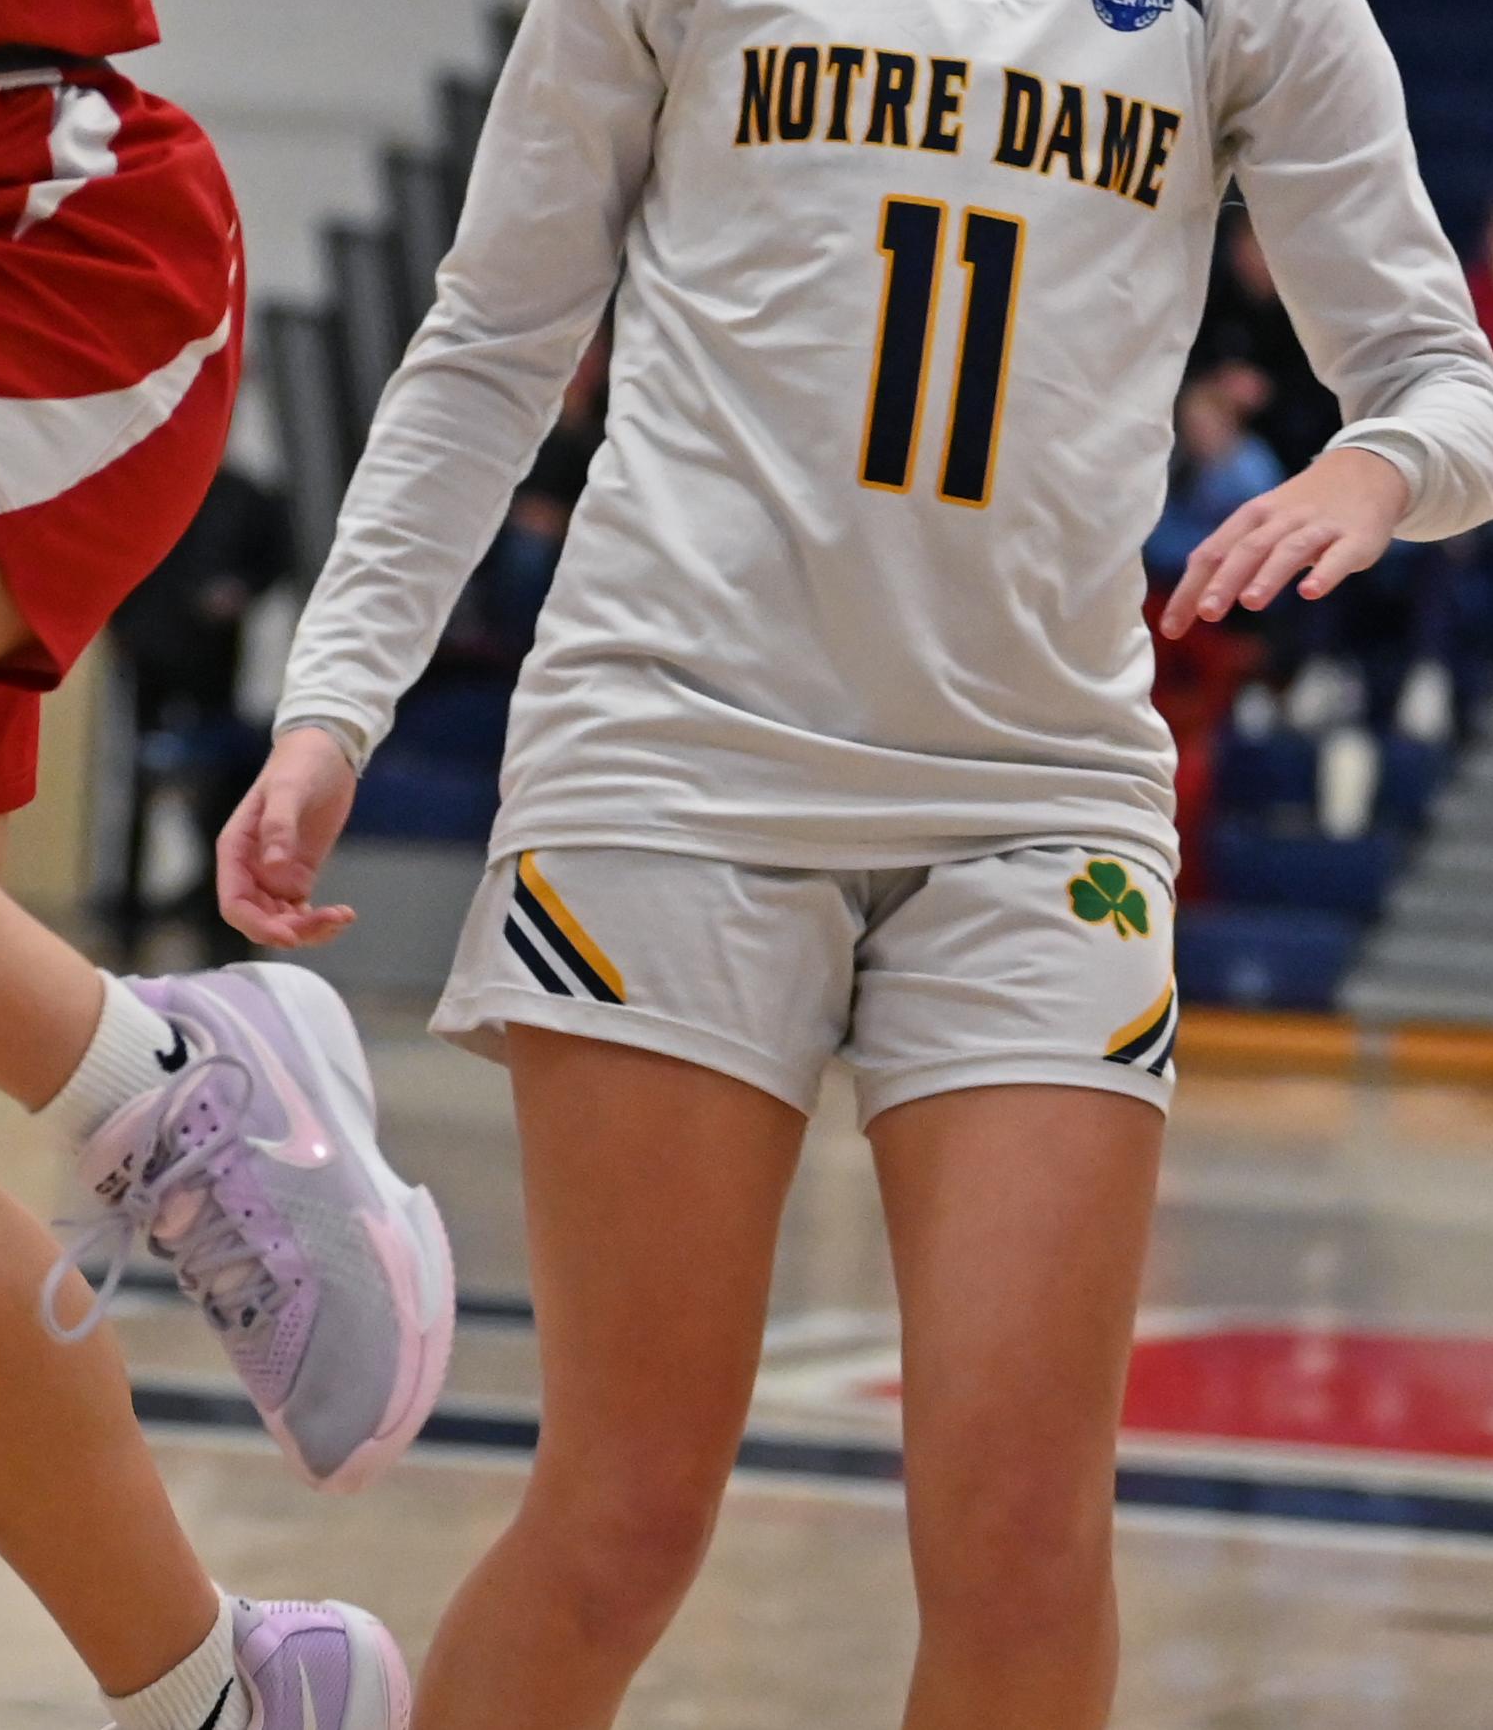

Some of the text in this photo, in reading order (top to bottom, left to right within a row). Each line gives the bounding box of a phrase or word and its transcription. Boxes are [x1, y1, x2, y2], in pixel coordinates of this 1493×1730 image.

[734, 42, 1183, 210] NOTRE DAME
[856, 192, 1026, 510] 11
